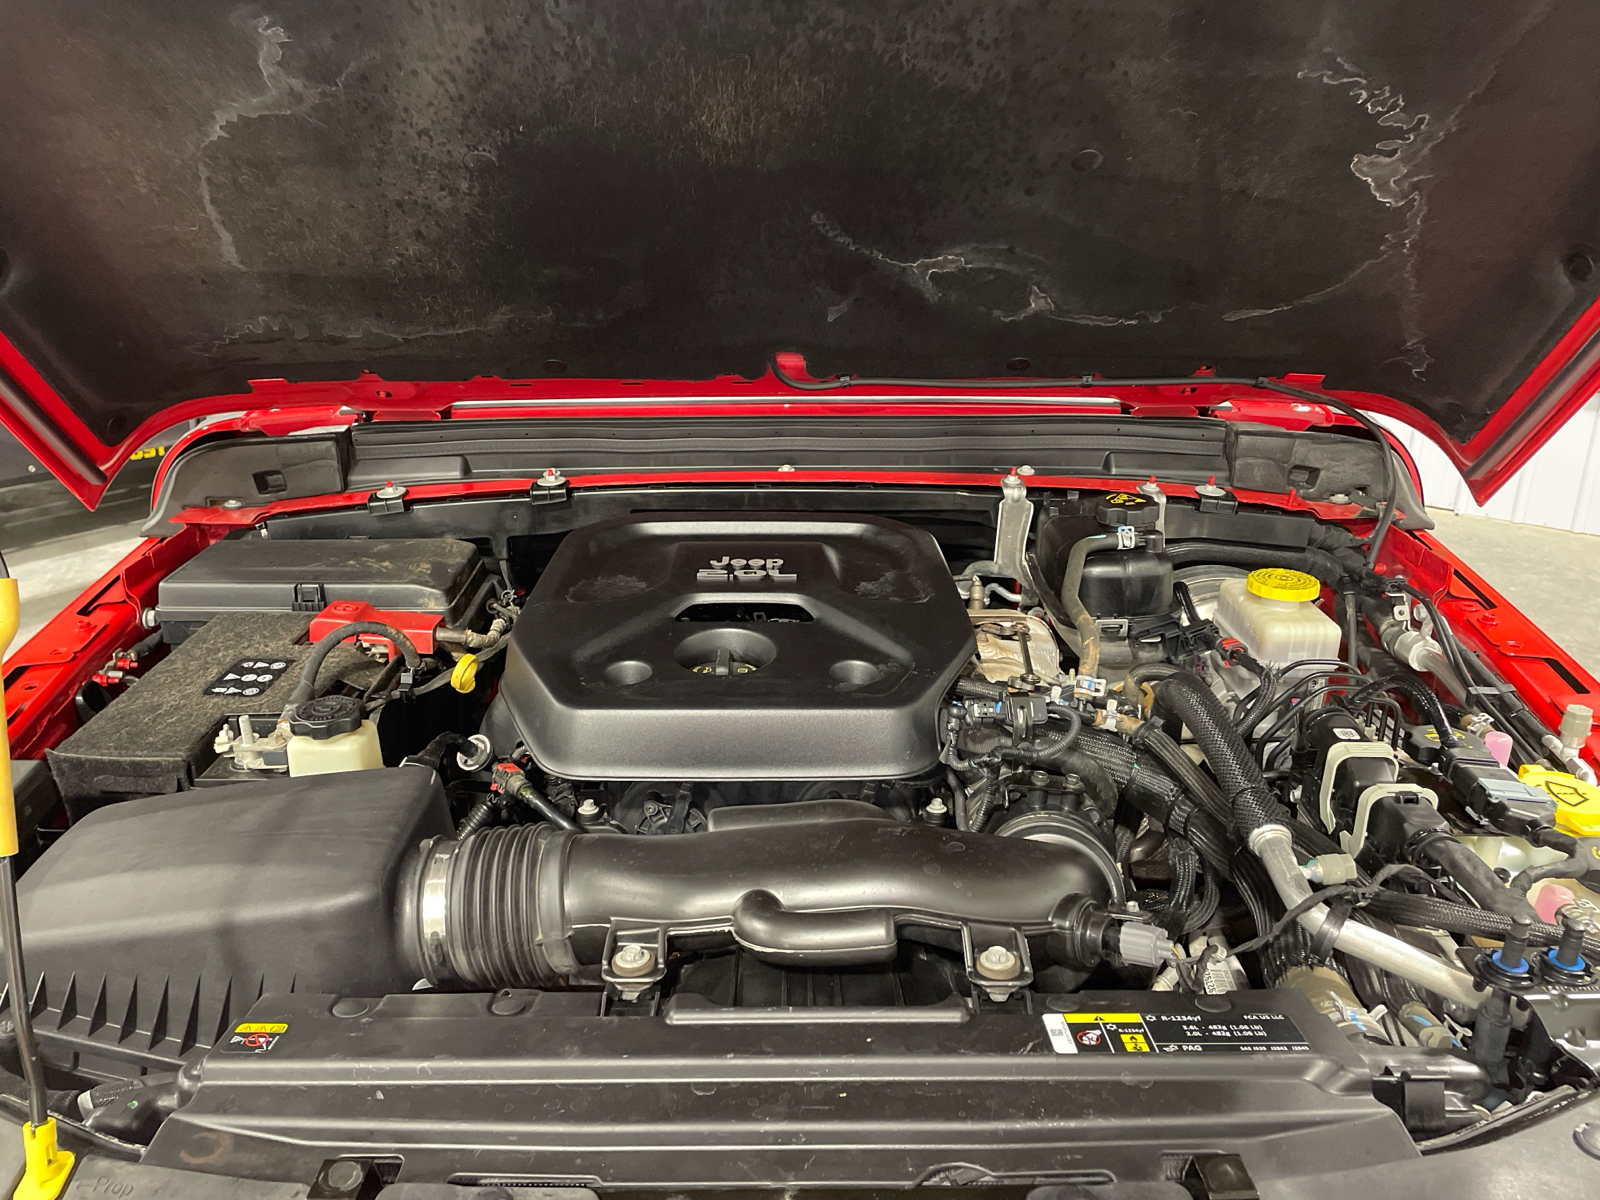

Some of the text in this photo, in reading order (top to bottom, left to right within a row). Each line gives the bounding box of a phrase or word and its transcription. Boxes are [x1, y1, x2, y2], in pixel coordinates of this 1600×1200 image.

[709, 556, 784, 570] Jeep
[696, 569, 798, 581] 2.0L
[93, 1177, 134, 1198] Prop
